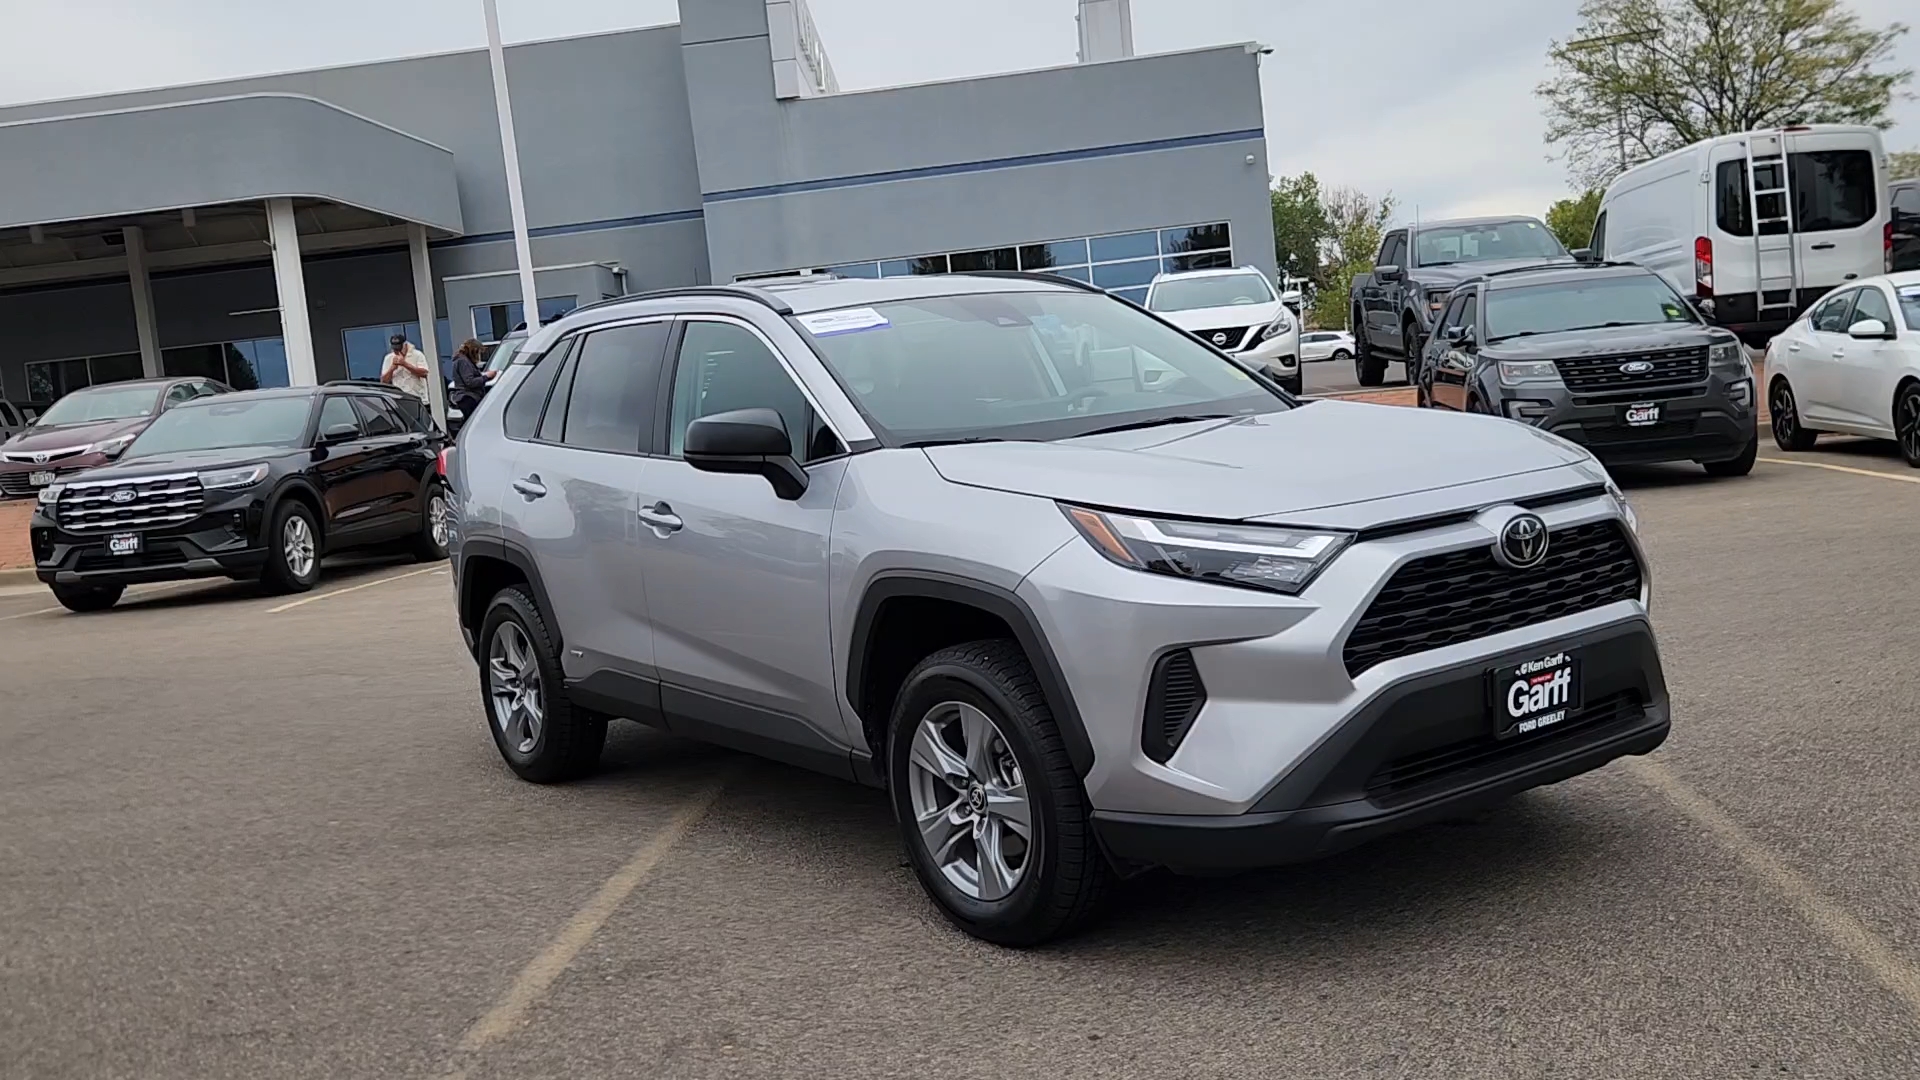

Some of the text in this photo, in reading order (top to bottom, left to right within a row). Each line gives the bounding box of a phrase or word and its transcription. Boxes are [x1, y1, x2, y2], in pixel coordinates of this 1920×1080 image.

[1626, 407, 1659, 421] Garff
[110, 537, 138, 551] Garff
[1528, 652, 1564, 673] Ken Garff
[1507, 667, 1571, 717] Garff
[1519, 710, 1565, 733] FORD GREELEY
